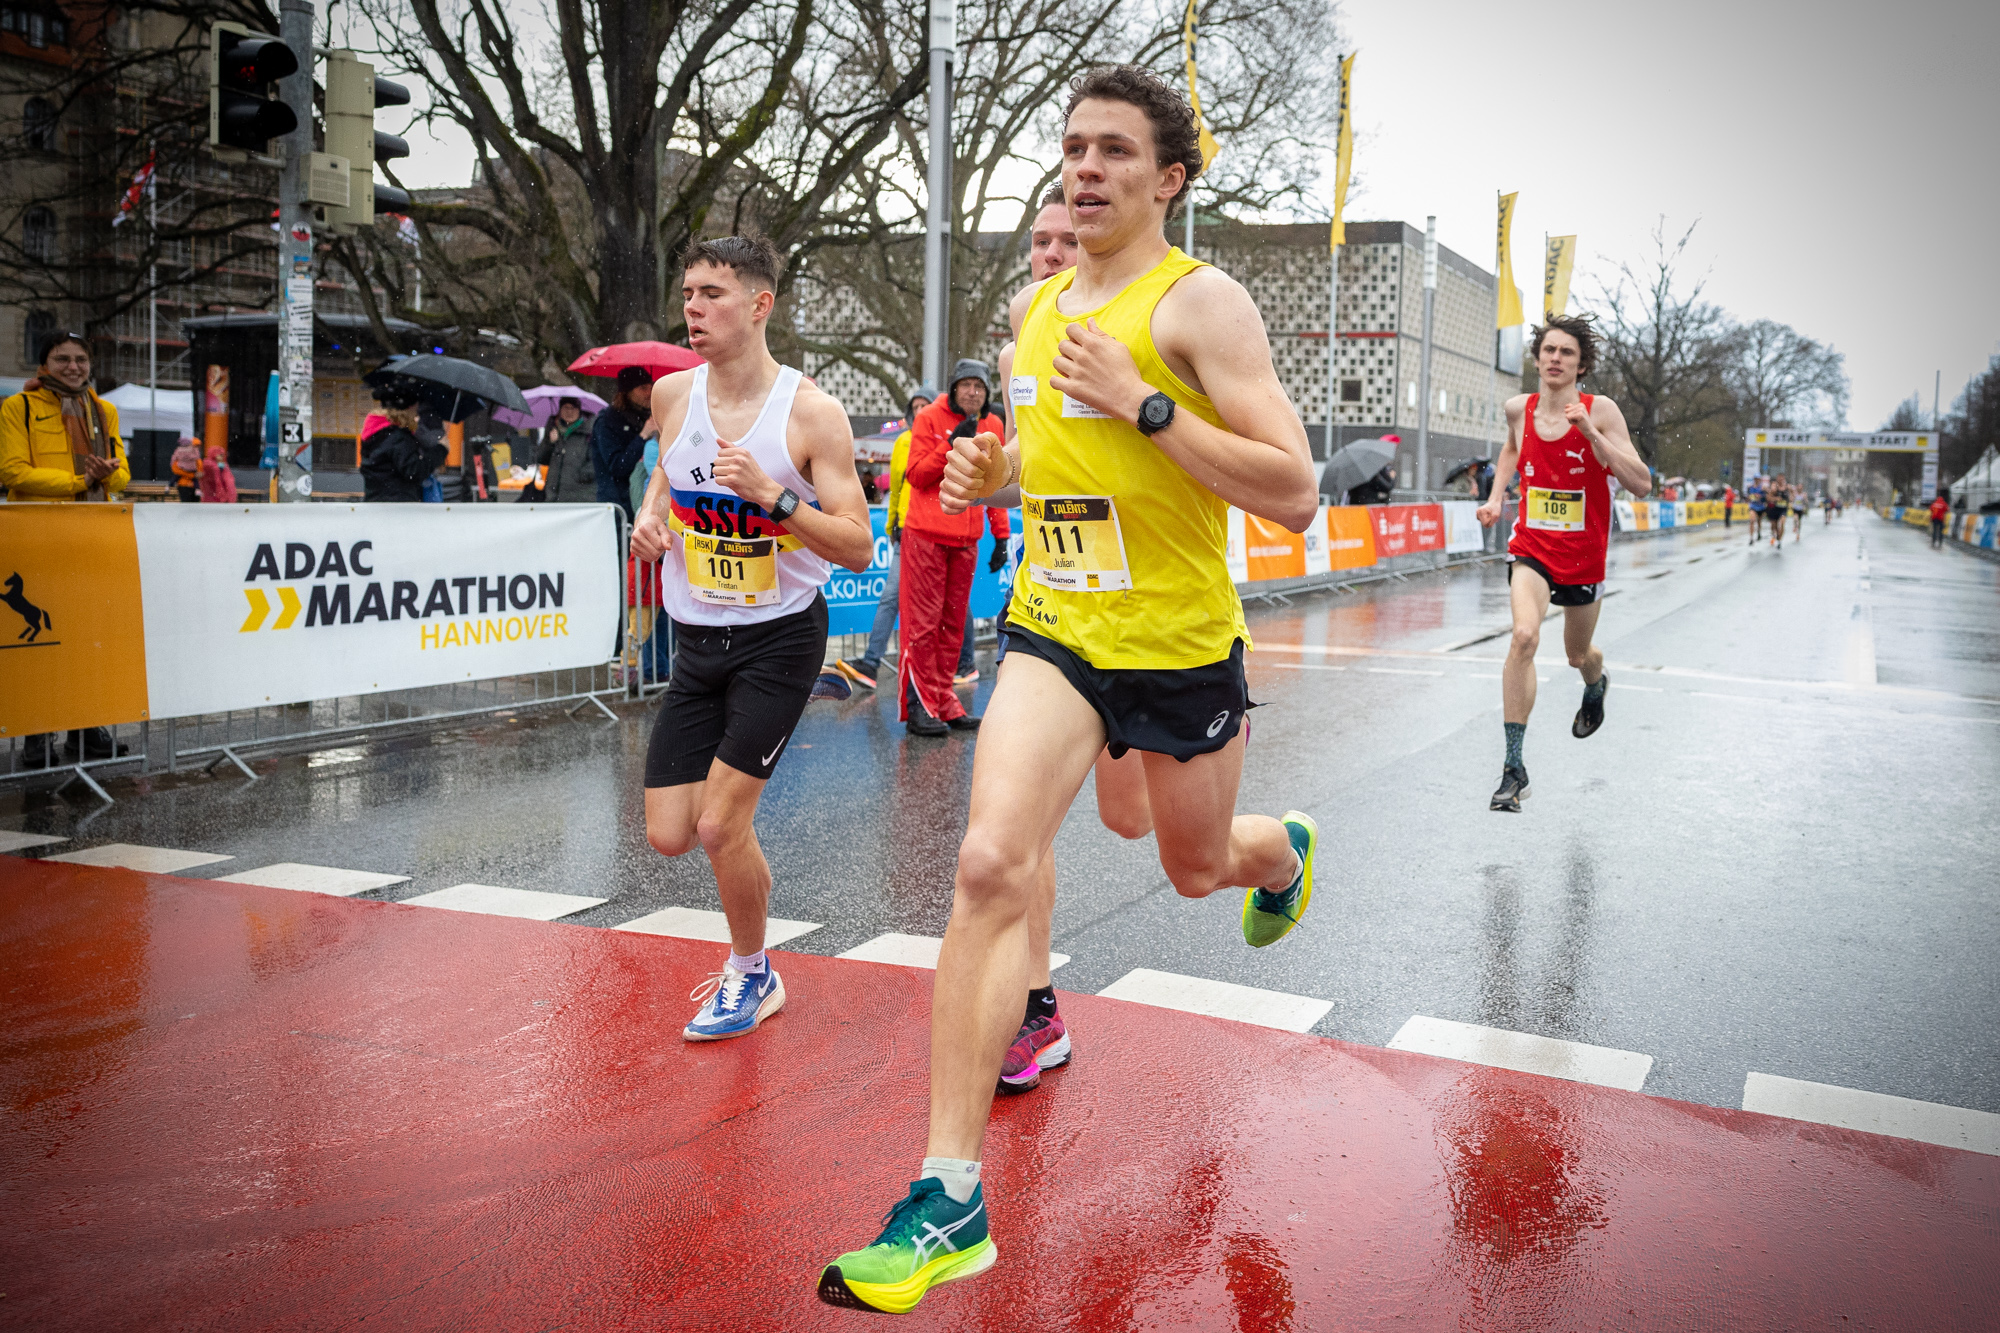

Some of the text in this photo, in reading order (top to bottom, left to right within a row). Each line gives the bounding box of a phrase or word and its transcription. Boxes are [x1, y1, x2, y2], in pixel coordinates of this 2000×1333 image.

[1773, 433, 1811, 444] START
[1870, 437, 1909, 447] START
[1051, 503, 1088, 515] TALENTS
[1544, 501, 1567, 515] 108
[694, 496, 762, 540] SSC
[1039, 525, 1084, 554] 111
[723, 543, 754, 553] TALENTS
[244, 540, 374, 582] ADAC
[1053, 558, 1076, 568] Julian
[707, 557, 745, 581] 101
[717, 580, 738, 590] Tristan
[1047, 576, 1076, 584] MARATHON
[821, 577, 886, 600] LKOHO
[304, 572, 565, 628] MARATHON
[420, 612, 570, 650] HANNOVER
